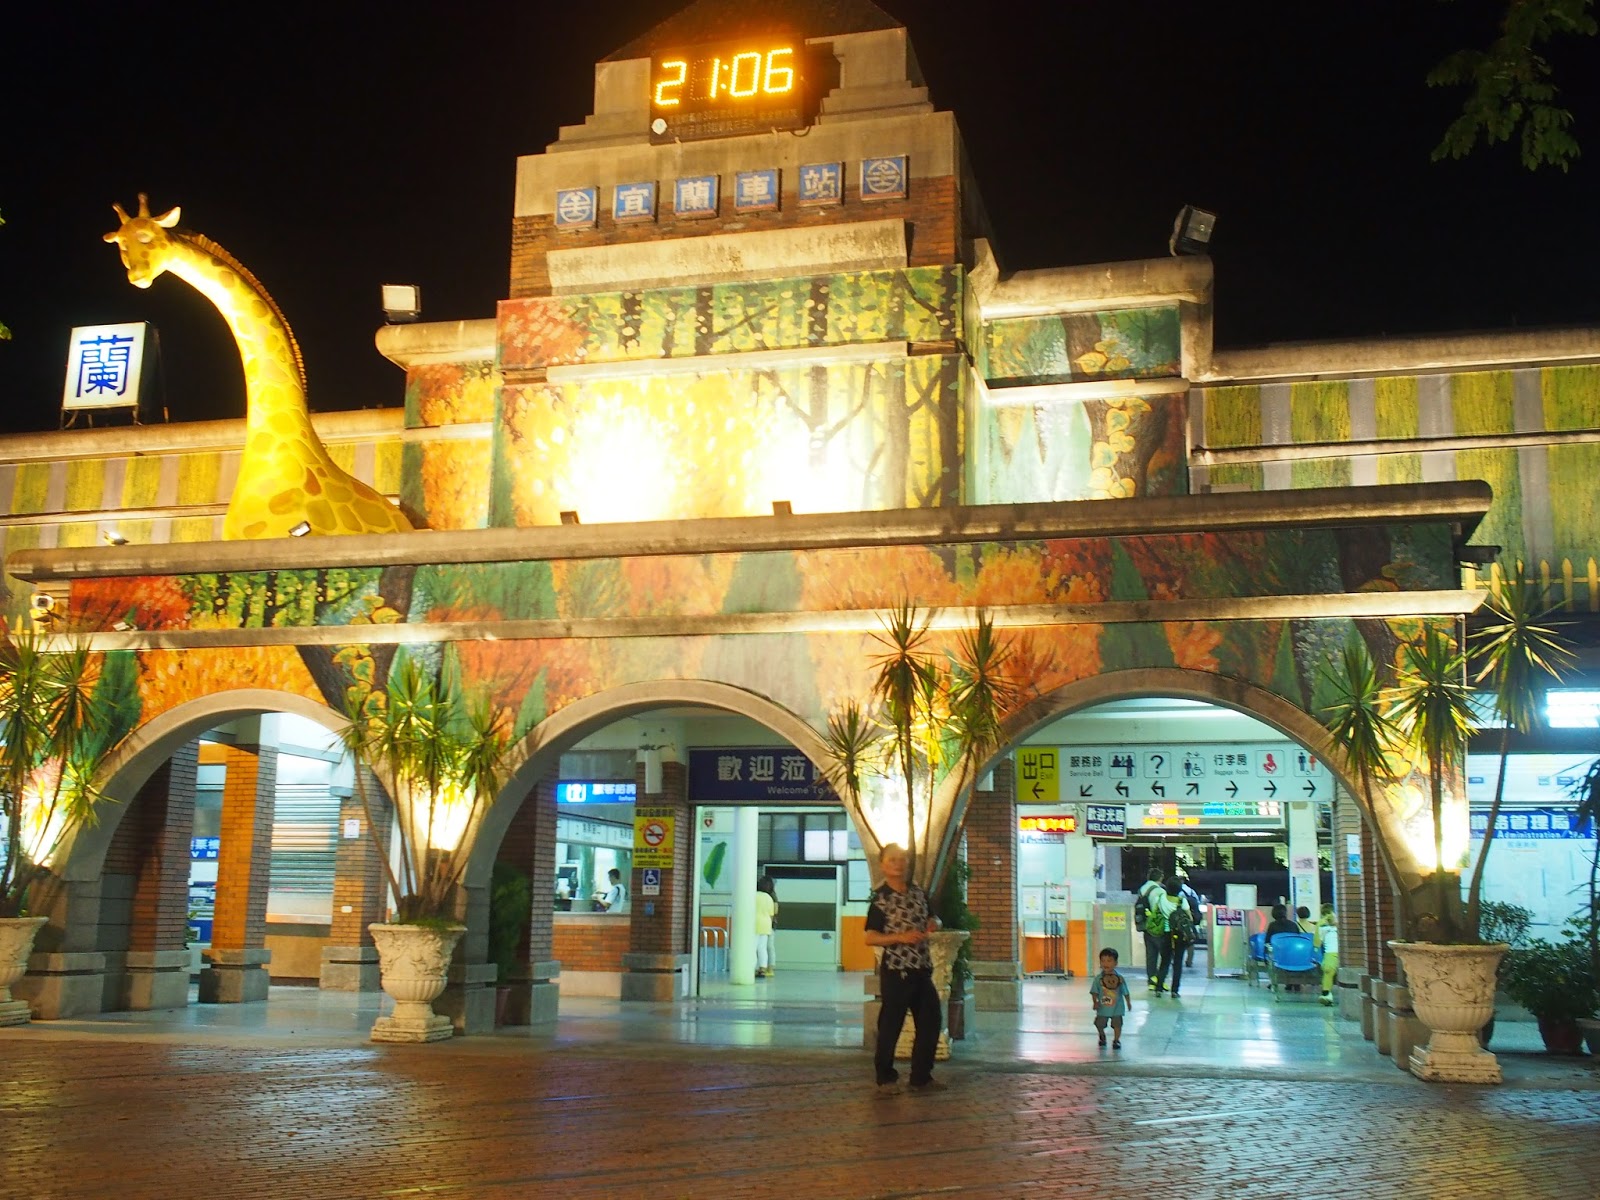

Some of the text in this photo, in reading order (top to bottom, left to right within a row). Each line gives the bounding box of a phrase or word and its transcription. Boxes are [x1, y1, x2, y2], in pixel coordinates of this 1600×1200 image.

[654, 47, 795, 106] 21:06
[619, 168, 835, 216] 宜蘭車站
[76, 334, 134, 398] 蘭
[1023, 753, 1055, 780] 出口
[1213, 753, 1248, 766] 行李房
[767, 785, 809, 795] Welcome
[1087, 807, 1125, 823] 歡迎光臨
[1087, 822, 1124, 833] WELCOME
